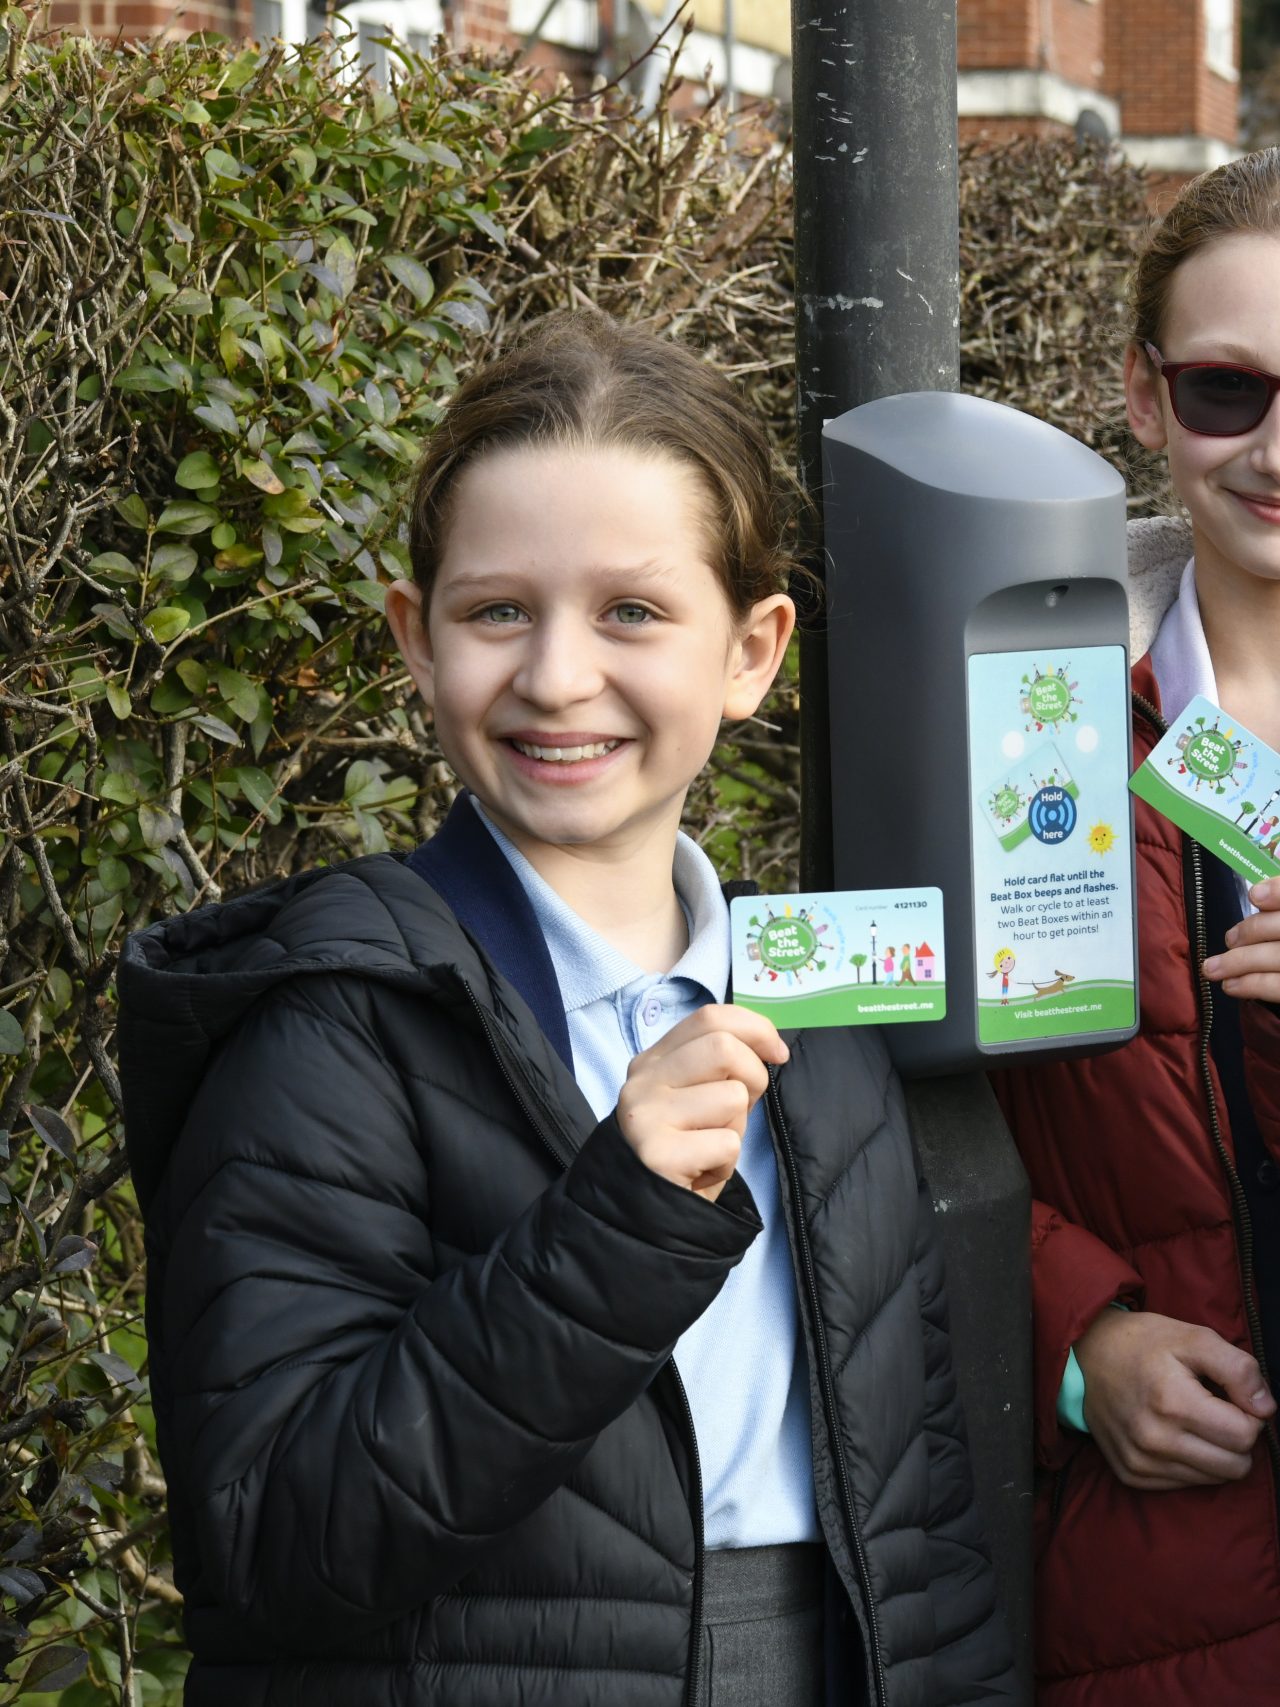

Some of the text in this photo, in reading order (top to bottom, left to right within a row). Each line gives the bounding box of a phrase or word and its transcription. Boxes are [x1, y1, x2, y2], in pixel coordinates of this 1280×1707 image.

[1035, 683, 1057, 696] Beat
[1042, 693, 1058, 702] the
[1035, 701, 1063, 710] Street
[1201, 736, 1226, 755] Beat
[1191, 748, 1221, 774] Street
[1202, 747, 1220, 764] the
[1041, 792, 1063, 802] Hold
[1043, 830, 1064, 840] here
[1218, 838, 1271, 880] beatthestreet.m
[1004, 870, 1105, 887] Hold card flat until the
[990, 882, 1119, 902] Beat Box beeps and flashes.
[894, 901, 928, 909] 4121130
[1000, 897, 1110, 914] Walk or cycle to at least
[997, 911, 1113, 929] two Beat Boxes within an
[768, 925, 798, 940] Beat
[1013, 924, 1099, 941] hour to get points!
[777, 936, 799, 948] the
[768, 945, 806, 957] Street
[857, 1001, 935, 1013] beatthestreet.me
[1014, 1004, 1102, 1019] Visit beatthestreet.me
